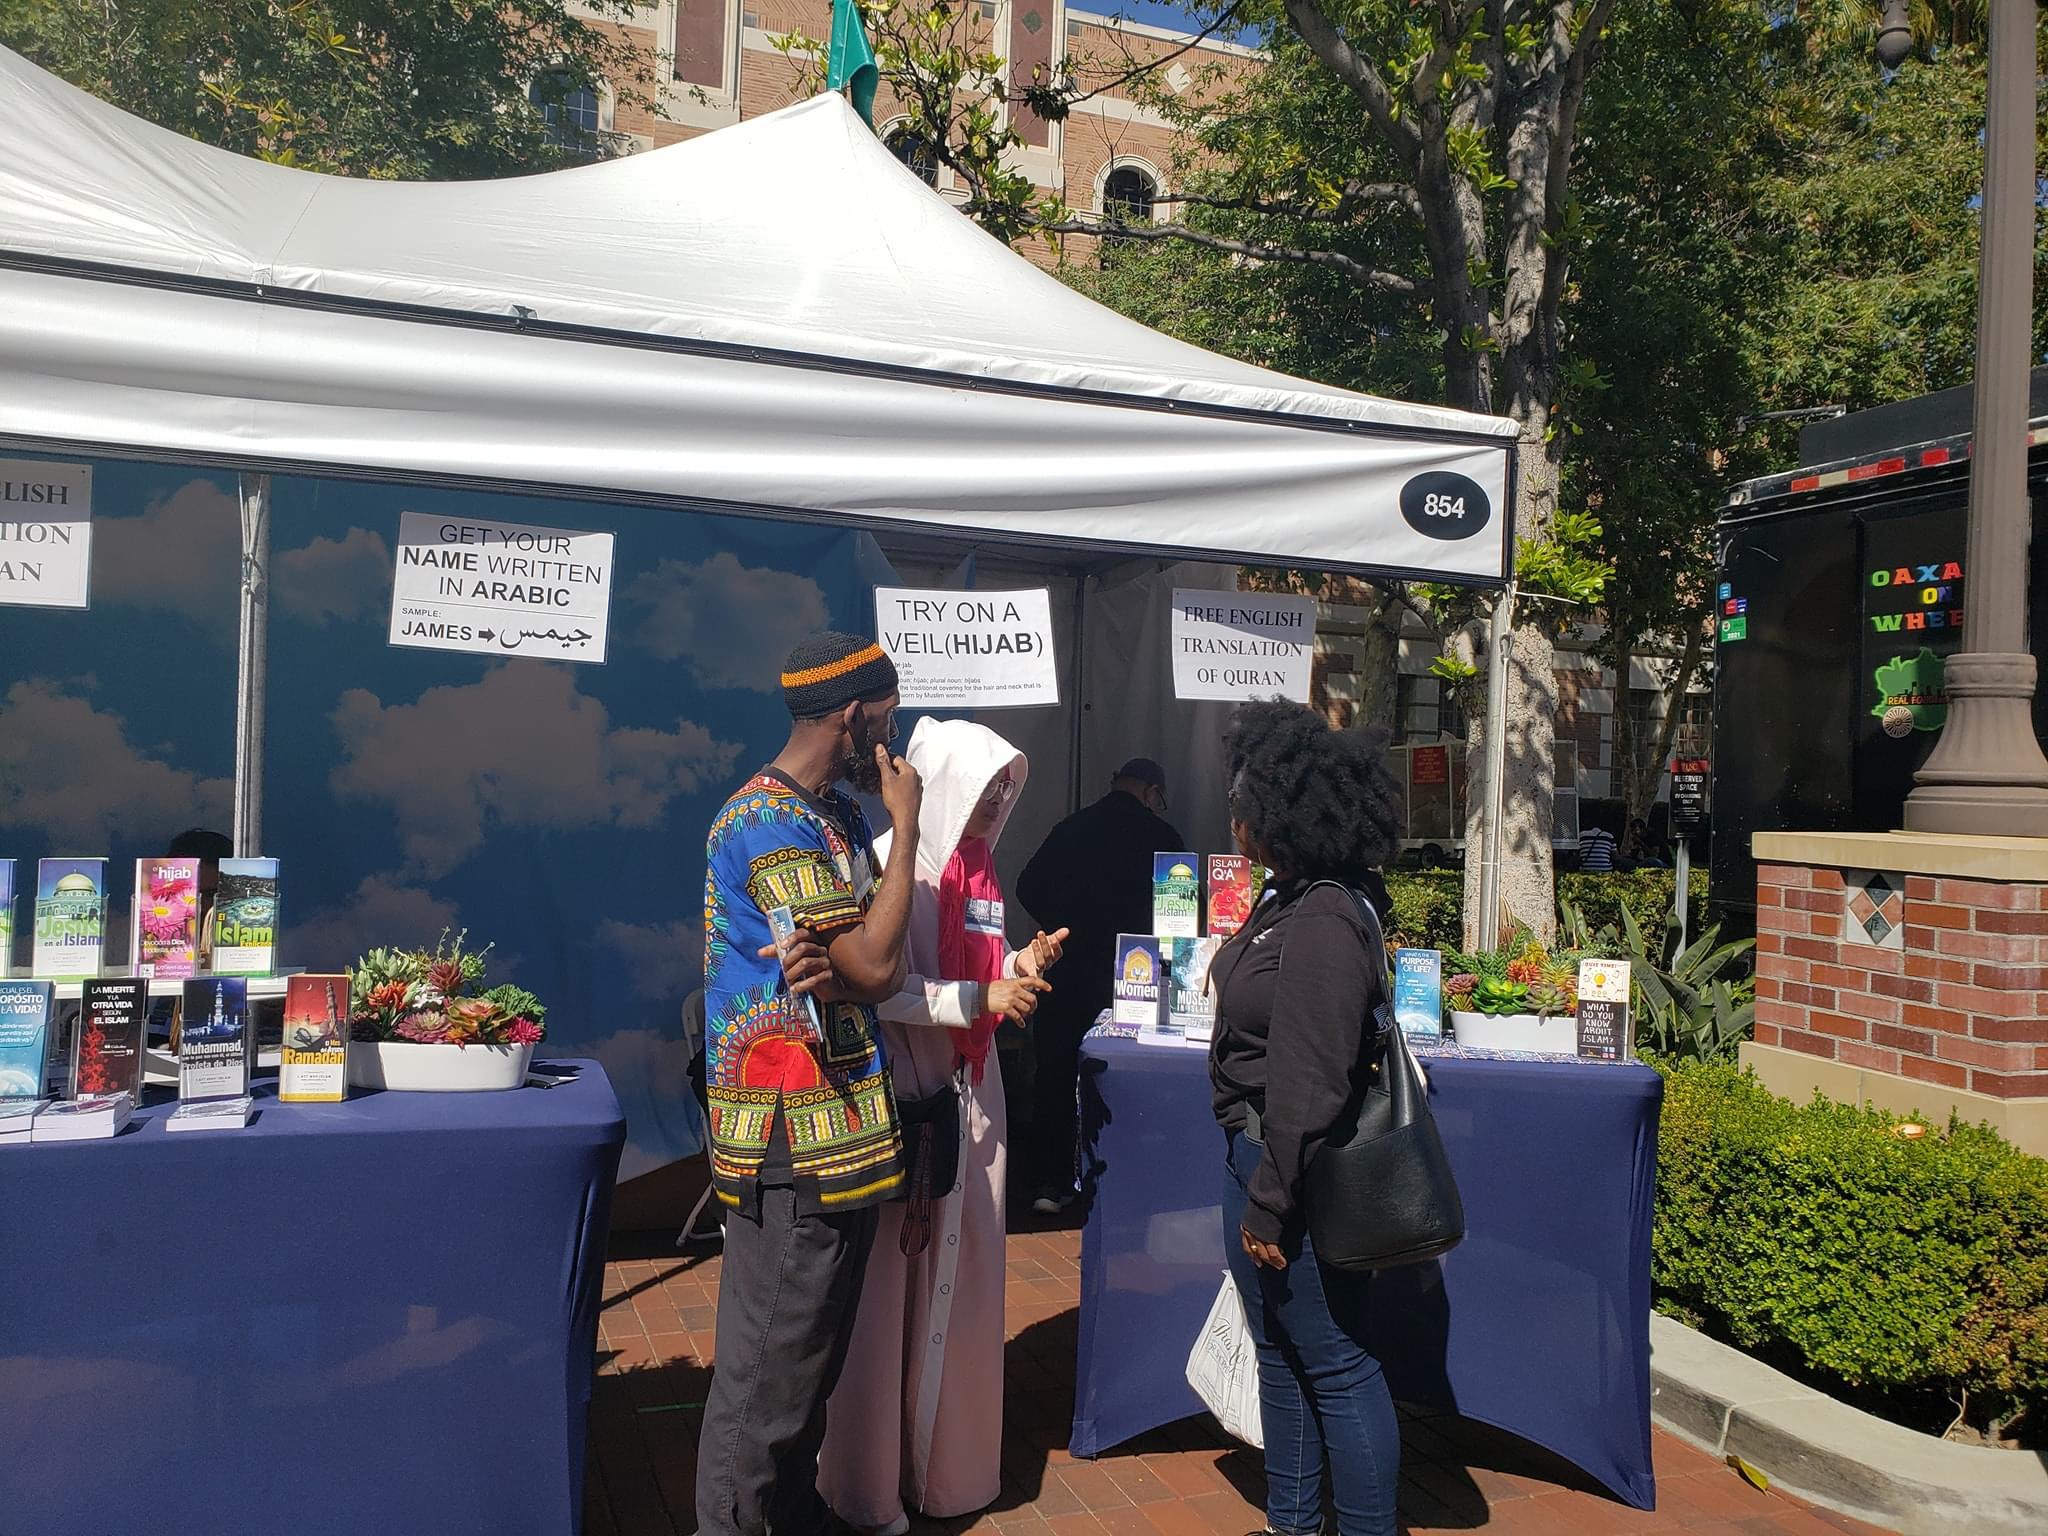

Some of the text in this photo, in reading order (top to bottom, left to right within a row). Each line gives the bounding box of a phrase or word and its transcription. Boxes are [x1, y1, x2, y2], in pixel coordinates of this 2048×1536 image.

[0, 481, 69, 505] LISH
[1424, 493, 1465, 519] 854
[0, 521, 72, 545] TION
[440, 524, 571, 555] GET YOUR
[403, 546, 602, 585] NAME WRITTEN
[1871, 562, 1965, 587] OAXA
[439, 577, 571, 607] IN ARABIC
[1922, 586, 1952, 605] ON
[402, 607, 442, 618] SAMPLE:
[896, 600, 1021, 623] TRY ON A
[1184, 606, 1303, 627] FREE ENGLISH
[1871, 610, 1964, 632] WHEE
[401, 621, 472, 641] JAMES
[499, 627, 593, 649] جيمس
[884, 631, 1043, 660] VEIL(HIJAB)
[1181, 637, 1303, 657] TRANSLATION
[1197, 668, 1286, 687] OF QURAN
[916, 692, 923, 700] by
[1888, 696, 1909, 705] REAL
[1212, 859, 1241, 868] ISLAM
[158, 866, 192, 881] hijab
[1163, 907, 1187, 917] Islam
[64, 932, 101, 946] Islam
[215, 920, 273, 945] Islam
[1400, 957, 1435, 966] PURPOSE
[1402, 965, 1413, 973] OF
[91, 986, 135, 994] LA MUERTE
[1116, 980, 1158, 998] Women
[14, 1005, 42, 1014] VIDA?
[91, 1001, 133, 1009] OTRA VIDA
[1586, 1003, 1611, 1012] WHAT
[1585, 1019, 1610, 1028] KNOW
[1597, 1012, 1614, 1020] YOU
[182, 1039, 244, 1056] Muhammad,
[1582, 1035, 1614, 1045] ISLAM?
[226, 1058, 244, 1067] Dios
[284, 1048, 344, 1065] Ramadan
